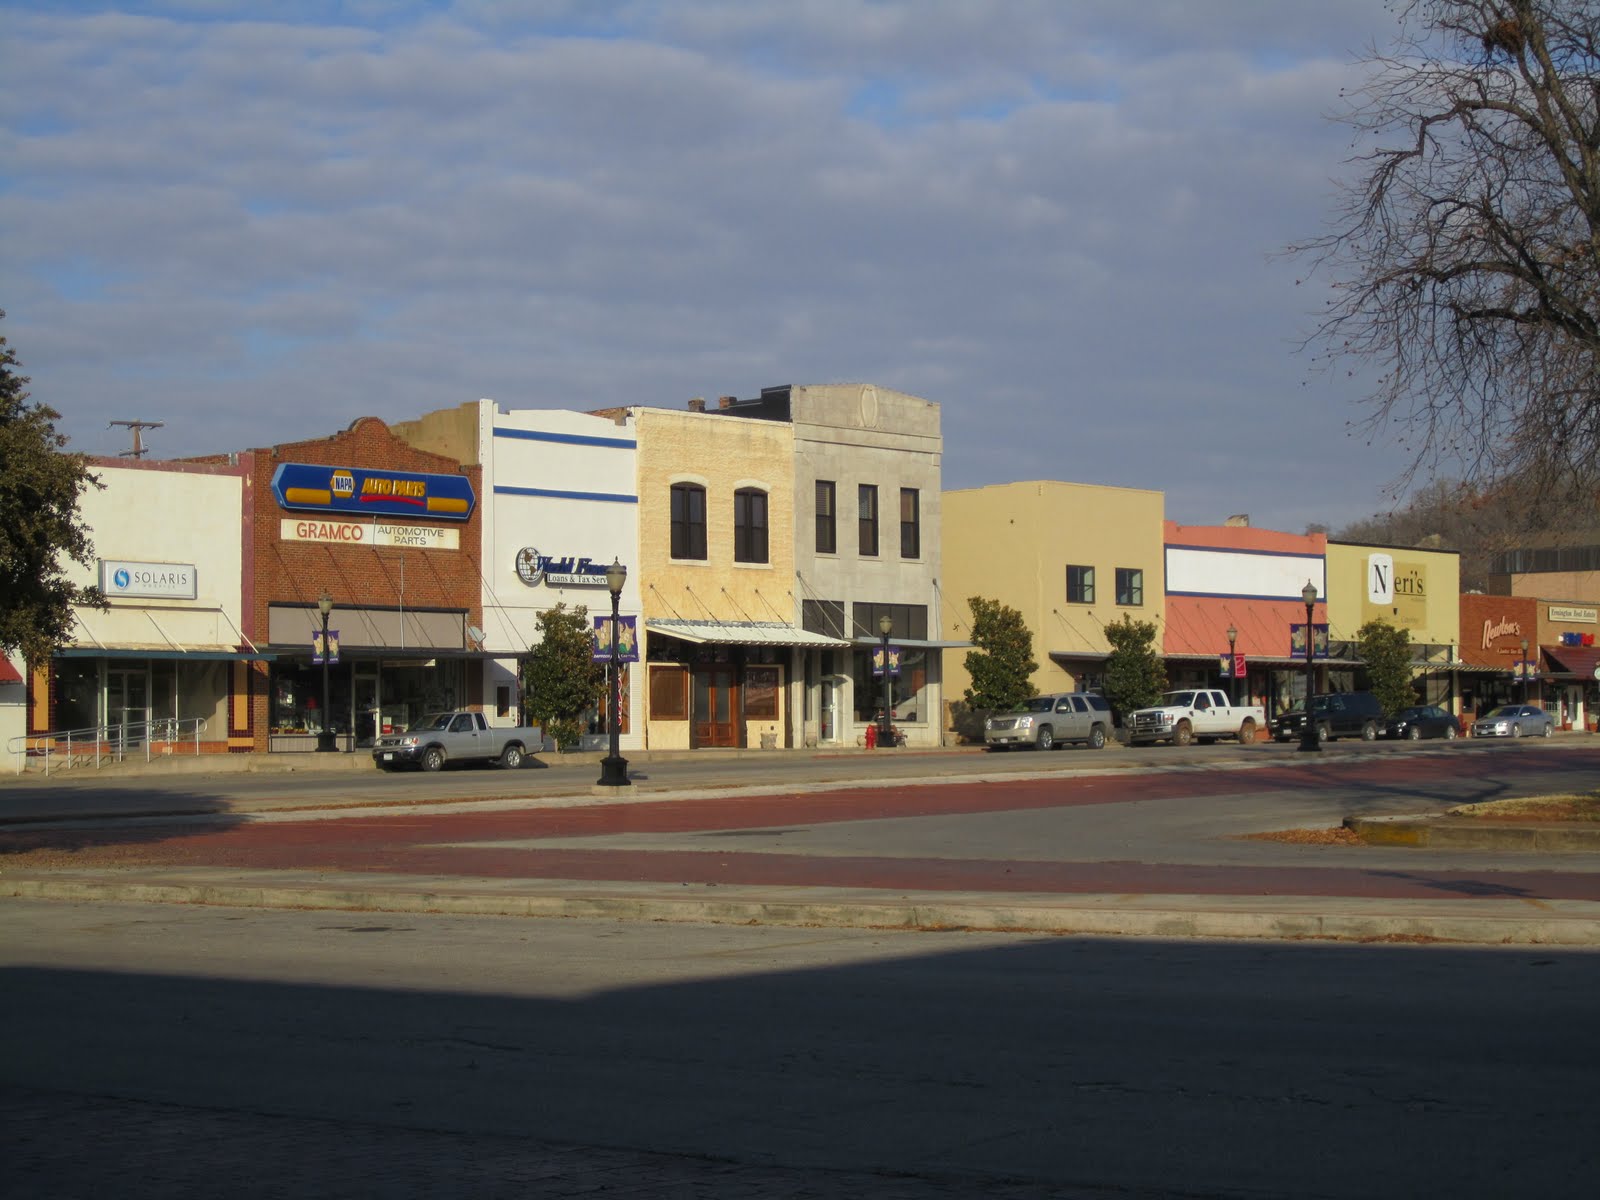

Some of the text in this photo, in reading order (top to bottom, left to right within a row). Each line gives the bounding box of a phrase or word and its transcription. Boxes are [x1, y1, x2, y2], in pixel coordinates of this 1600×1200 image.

[335, 476, 353, 491] NAPA
[361, 477, 426, 497] AUTO PARTS
[296, 522, 363, 541] GRAMCO
[377, 526, 445, 538] AUTOMOTIVE
[394, 535, 427, 546] PARTS
[134, 571, 187, 585] SOLARIS
[548, 573, 569, 584] Loans
[570, 574, 576, 583] &
[578, 575, 591, 584] Tax
[1373, 564, 1424, 595] Neri's
